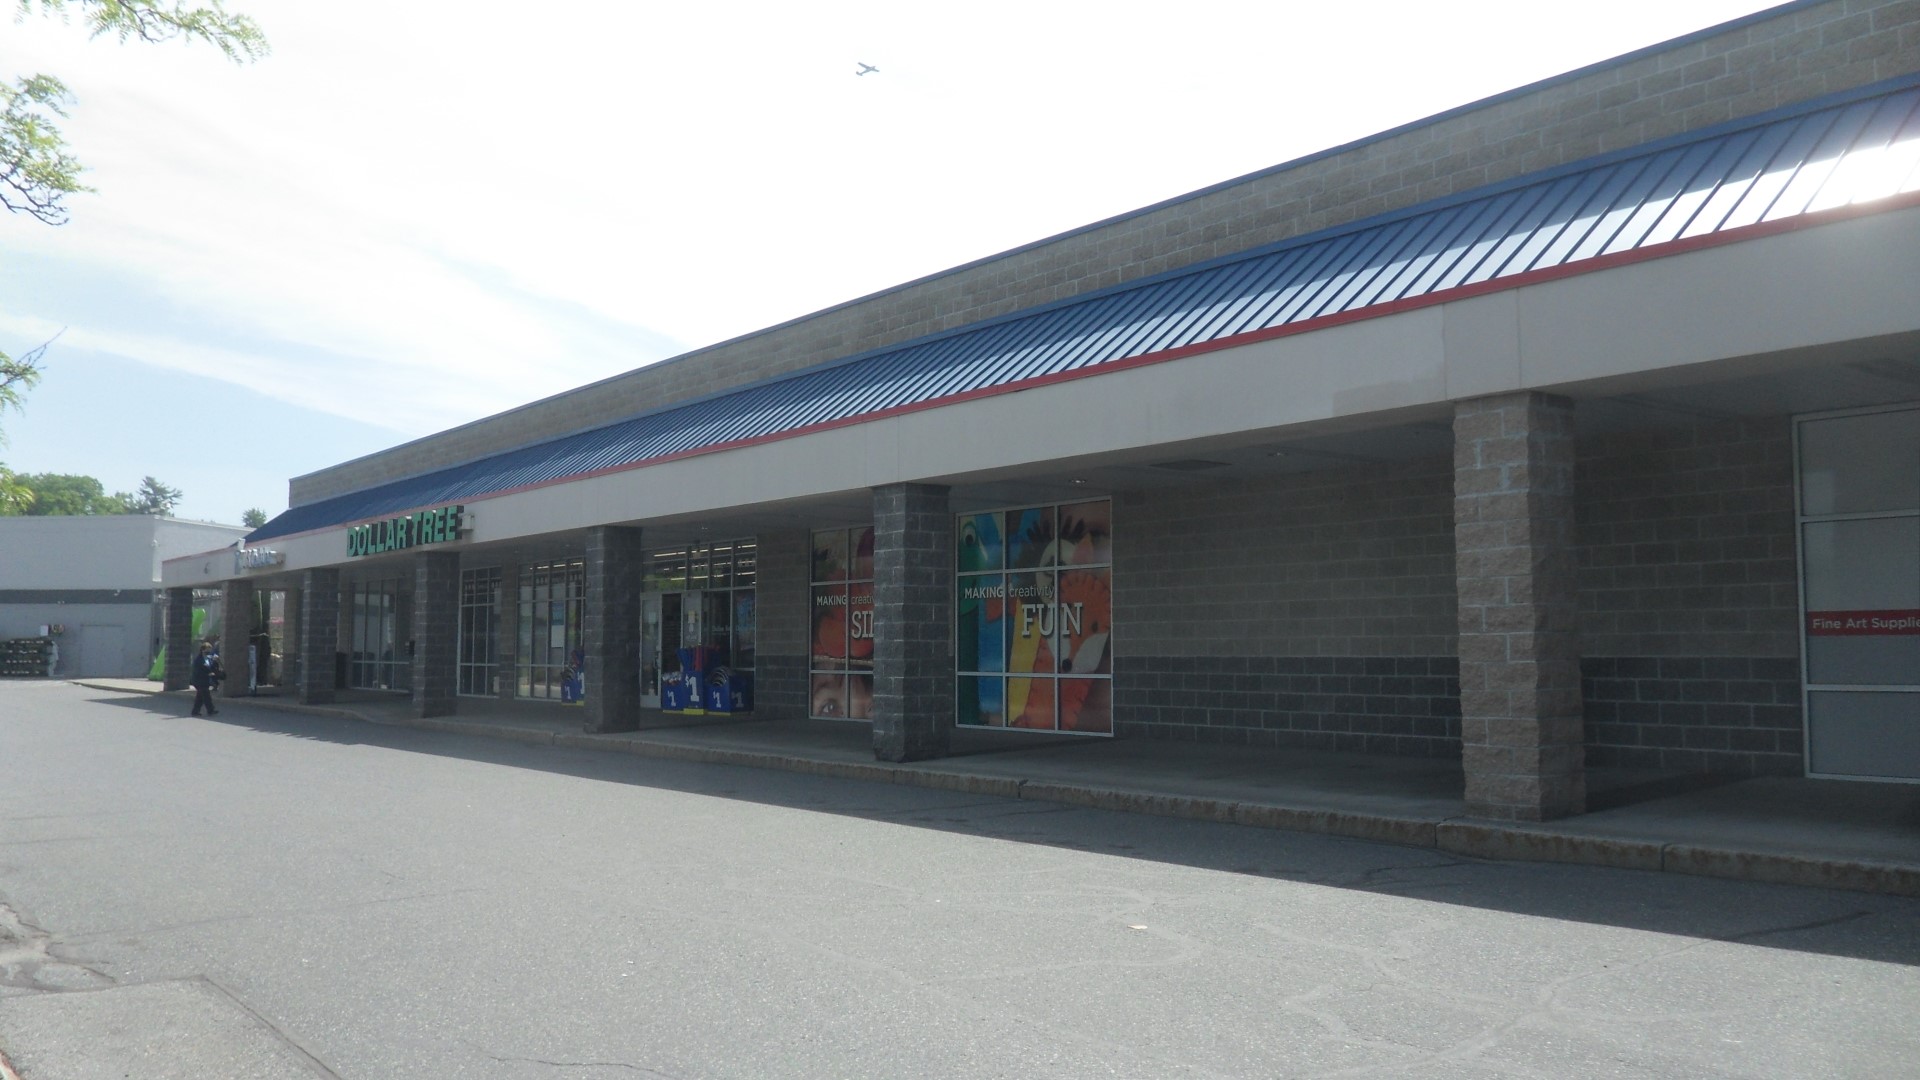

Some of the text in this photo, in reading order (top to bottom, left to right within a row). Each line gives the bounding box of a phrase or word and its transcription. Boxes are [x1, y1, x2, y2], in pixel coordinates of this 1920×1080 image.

[347, 505, 461, 557] DOLLAR TREE
[817, 594, 847, 606] MAKING
[964, 584, 1055, 599] MAKING creativity
[1022, 602, 1083, 636] FUN
[1812, 618, 1840, 629] Fine
[1846, 617, 1868, 629] Art
[685, 673, 699, 702] $1
